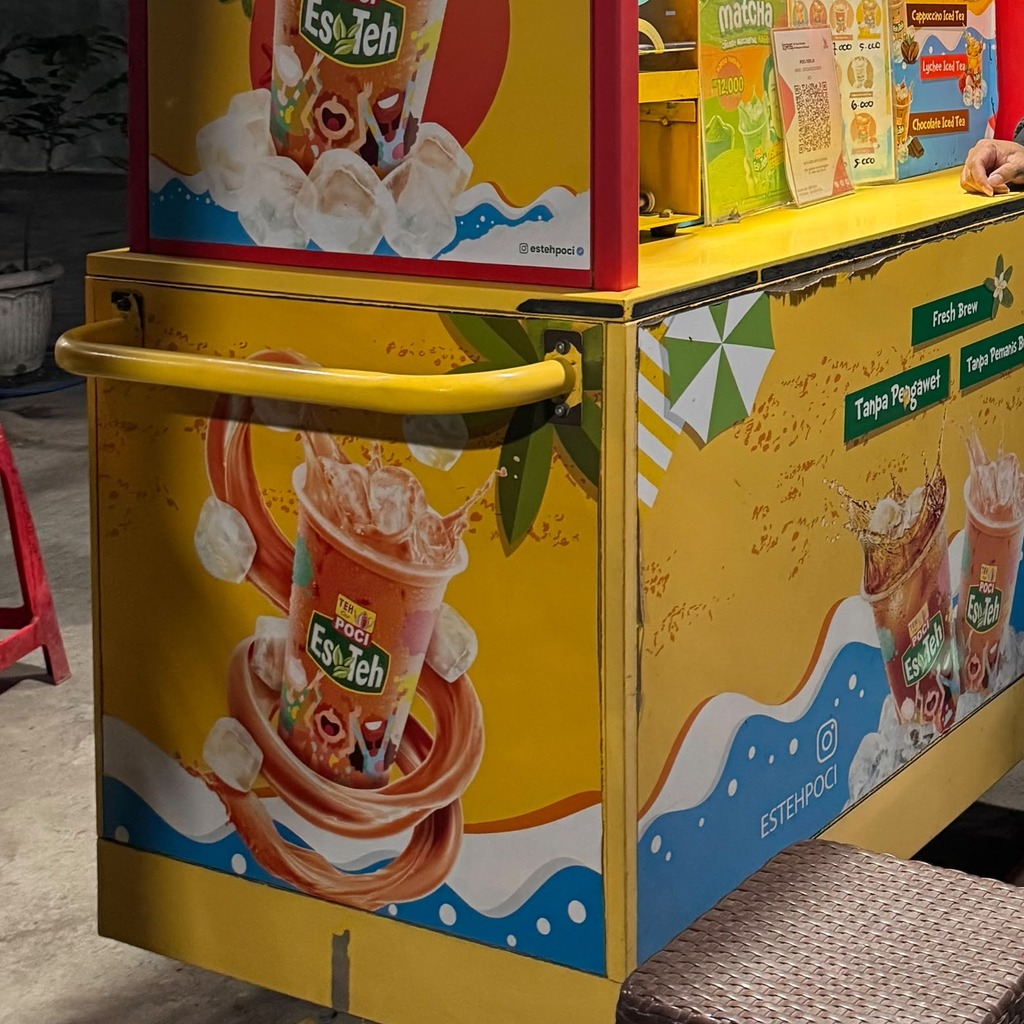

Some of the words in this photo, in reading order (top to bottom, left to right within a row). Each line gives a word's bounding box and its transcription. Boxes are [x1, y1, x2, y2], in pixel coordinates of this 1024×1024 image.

[911, 9, 942, 25] Cappuccino
[942, 10, 955, 22] Iced
[955, 9, 965, 22] Tea
[352, 7, 398, 57] Teh
[922, 60, 941, 74] Lychee
[941, 60, 954, 72] Iced
[954, 60, 966, 73] Tea
[851, 100, 874, 111] 6.000
[912, 117, 941, 131] Chocolate
[941, 116, 954, 128] Iced
[954, 115, 966, 127] Tea
[854, 157, 875, 168] 5.000
[530, 245, 575, 257] estehpoci
[932, 302, 956, 328] Fresh
[957, 300, 979, 319] Brew
[966, 352, 989, 374] Tanpa
[990, 341, 1018, 366] Pemanis
[854, 392, 889, 421] Tanpa
[978, 581, 995, 594] POCI
[338, 598, 354, 614] TEH
[967, 594, 979, 620] Es
[984, 595, 1000, 626] Teh
[335, 616, 370, 646] POCI
[911, 621, 930, 647] POCI
[310, 622, 335, 667] Es
[348, 643, 384, 688] Teh
[904, 656, 919, 681] Es
[922, 622, 943, 663] Teh
[760, 763, 838, 839] ESTEHPOCI
